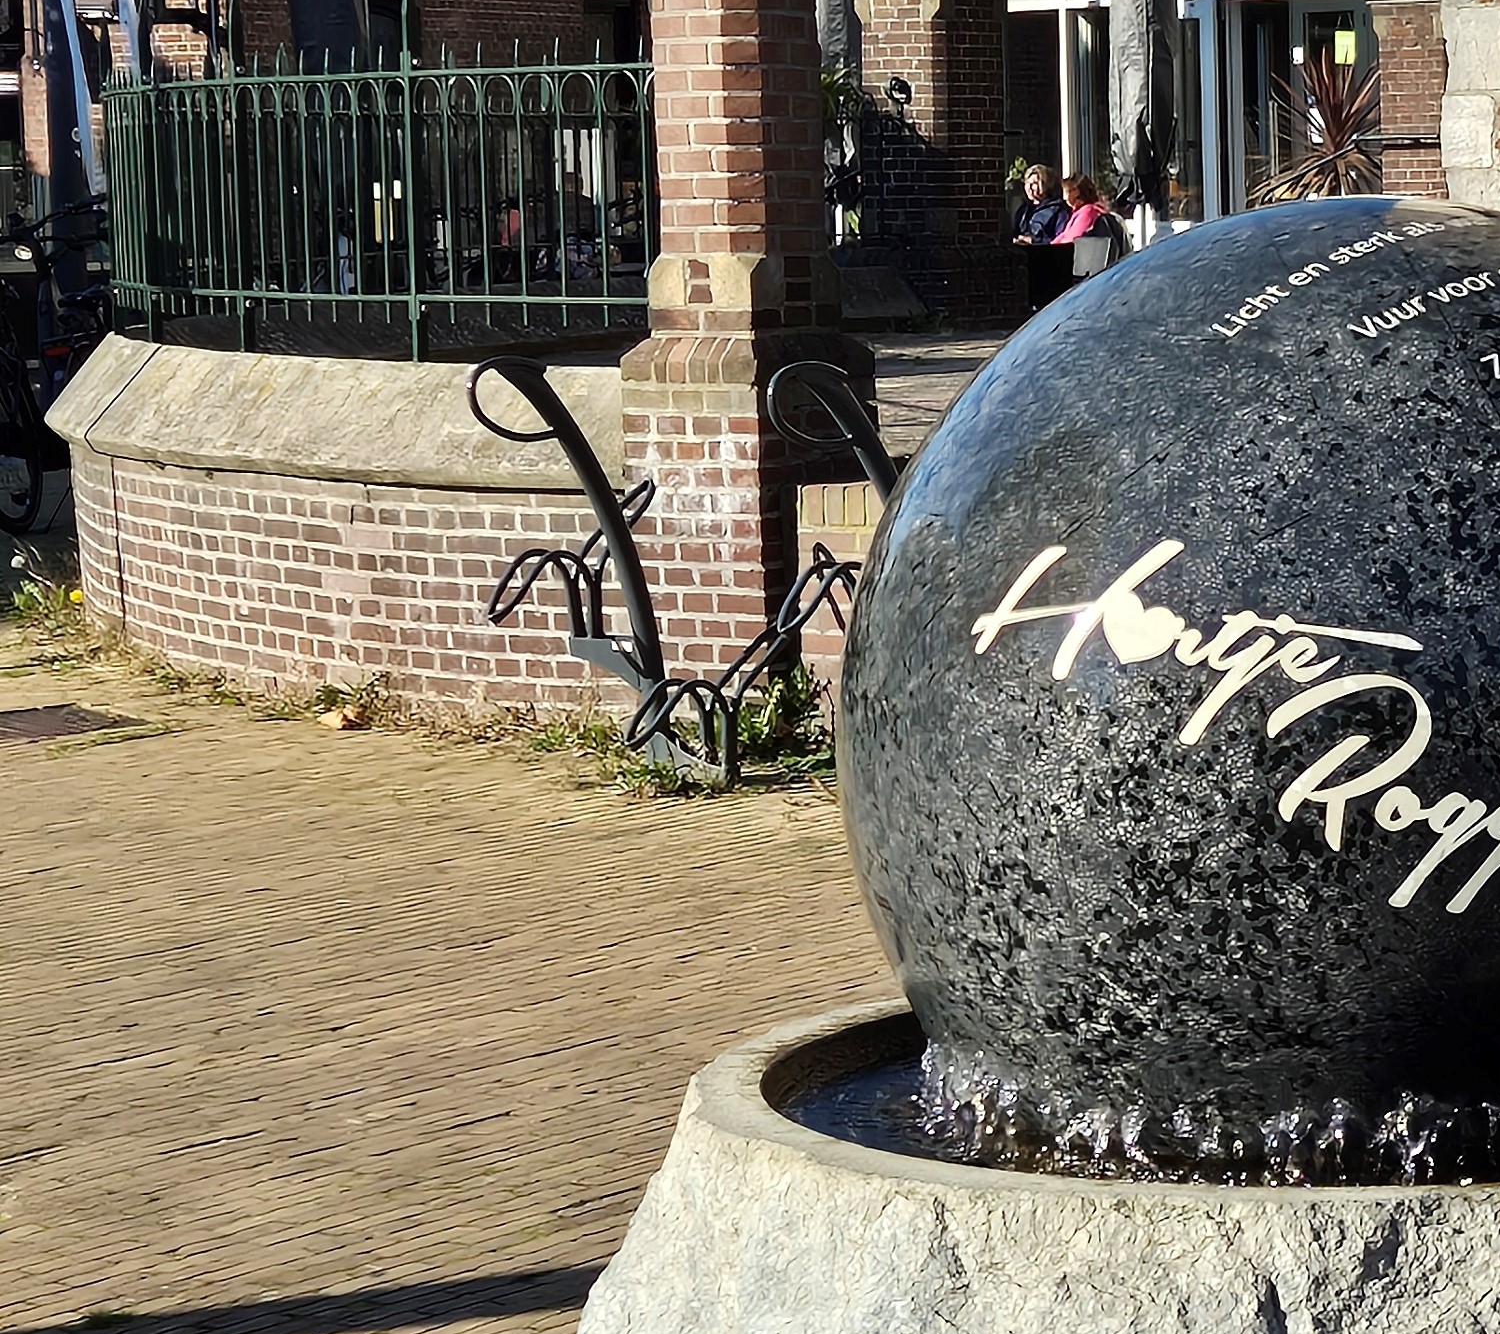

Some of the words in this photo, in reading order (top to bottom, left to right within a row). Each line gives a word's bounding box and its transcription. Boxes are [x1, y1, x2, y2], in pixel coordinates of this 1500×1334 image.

[1210, 284, 1291, 338] Licht
[1288, 262, 1331, 287] en
[1328, 230, 1404, 265] sterk
[1347, 295, 1427, 339] Vuur
[1426, 271, 1496, 305] voor
